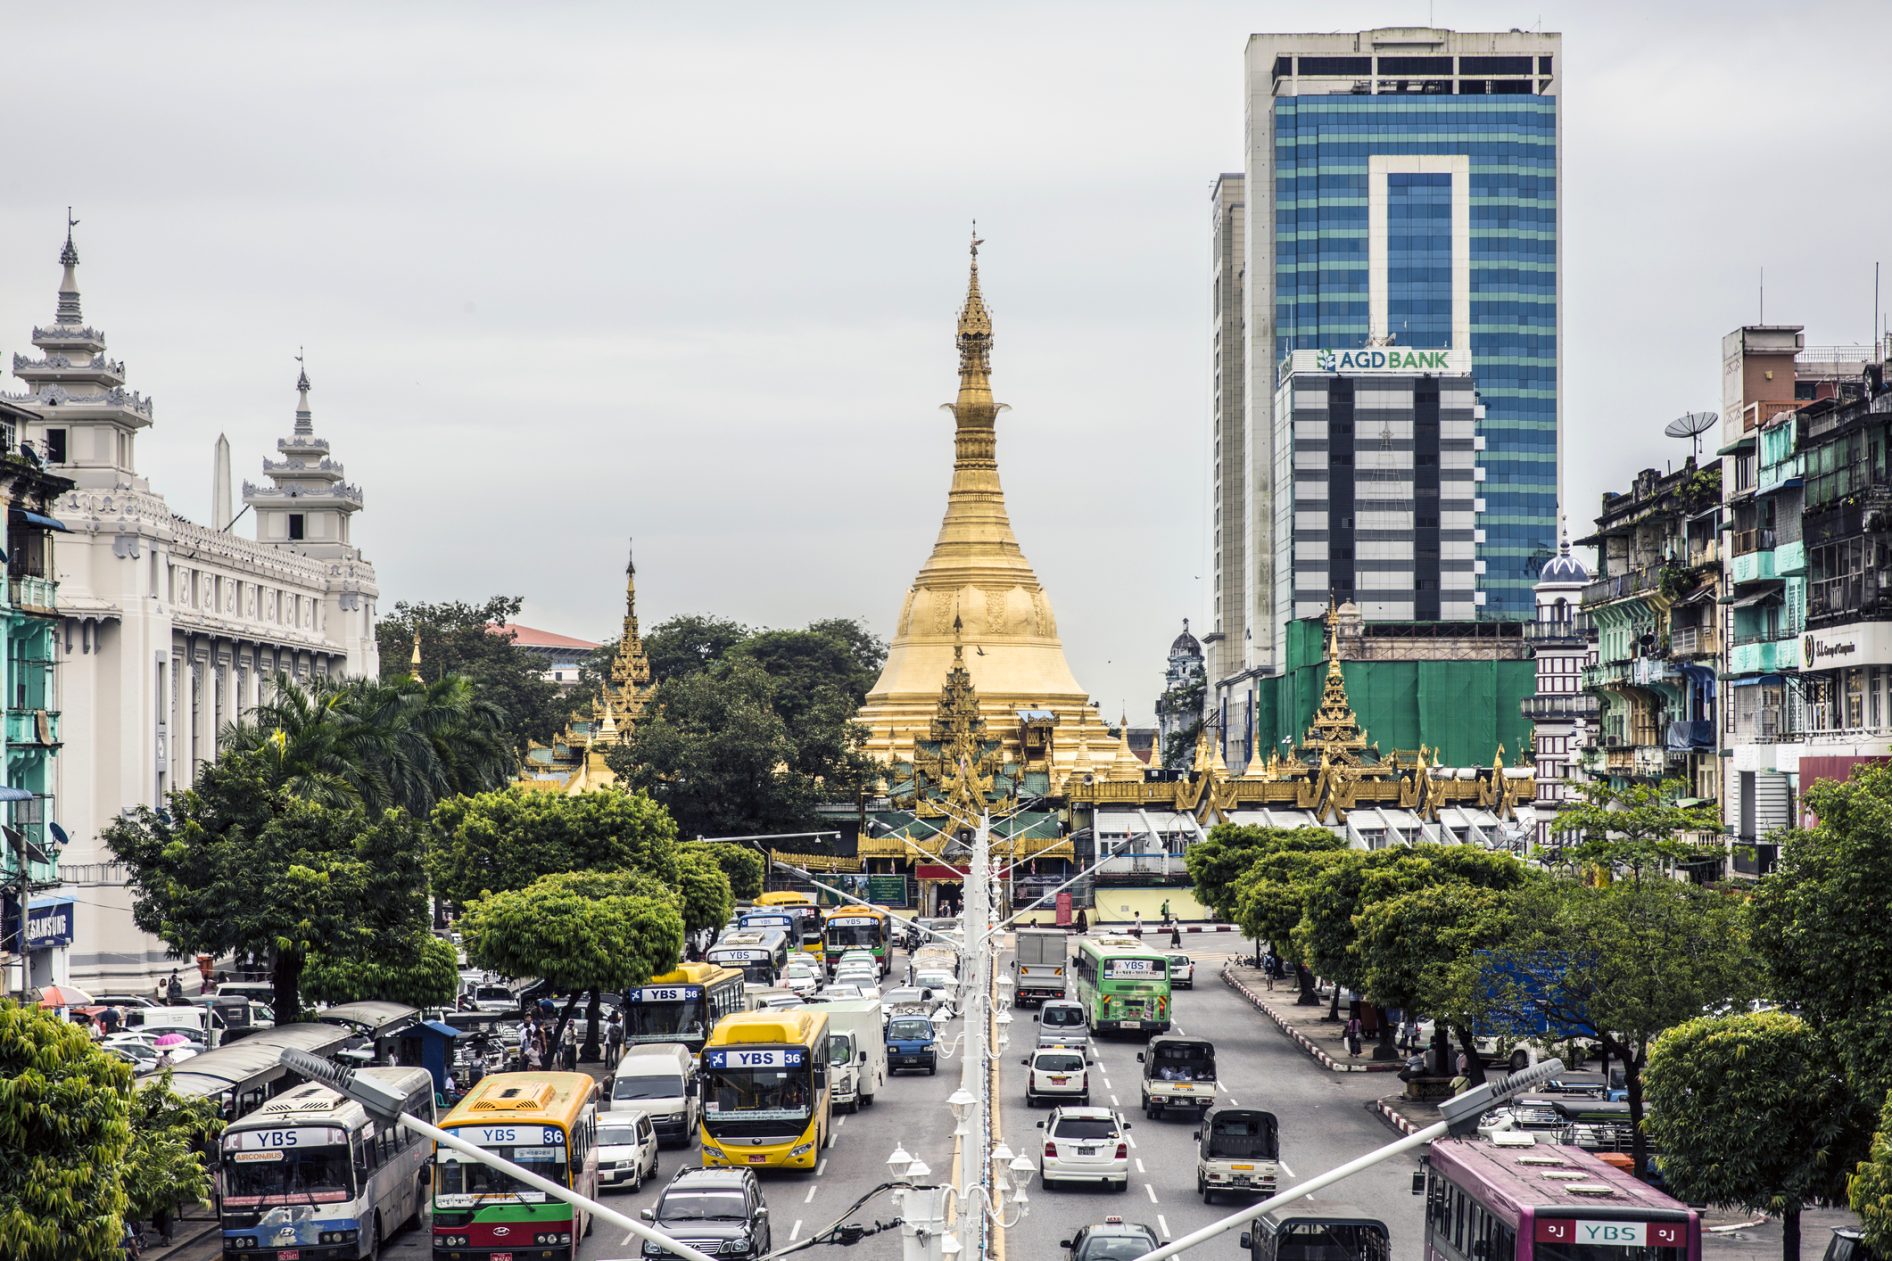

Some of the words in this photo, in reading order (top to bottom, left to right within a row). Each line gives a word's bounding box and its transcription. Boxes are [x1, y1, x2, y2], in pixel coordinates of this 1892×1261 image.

[1340, 352, 1385, 368] AGD
[1389, 352, 1449, 368] BANK
[29, 914, 66, 940] SAMSUNG
[730, 952, 750, 960] YBS
[1124, 961, 1144, 970] YBS
[651, 990, 677, 999] YBS
[686, 990, 698, 998] 36
[739, 1053, 774, 1065] YBS
[785, 1054, 800, 1063] 36
[257, 1131, 298, 1147] YBS
[483, 1128, 516, 1142] YBS
[544, 1130, 563, 1143] 36
[1585, 1225, 1636, 1241] YBS
